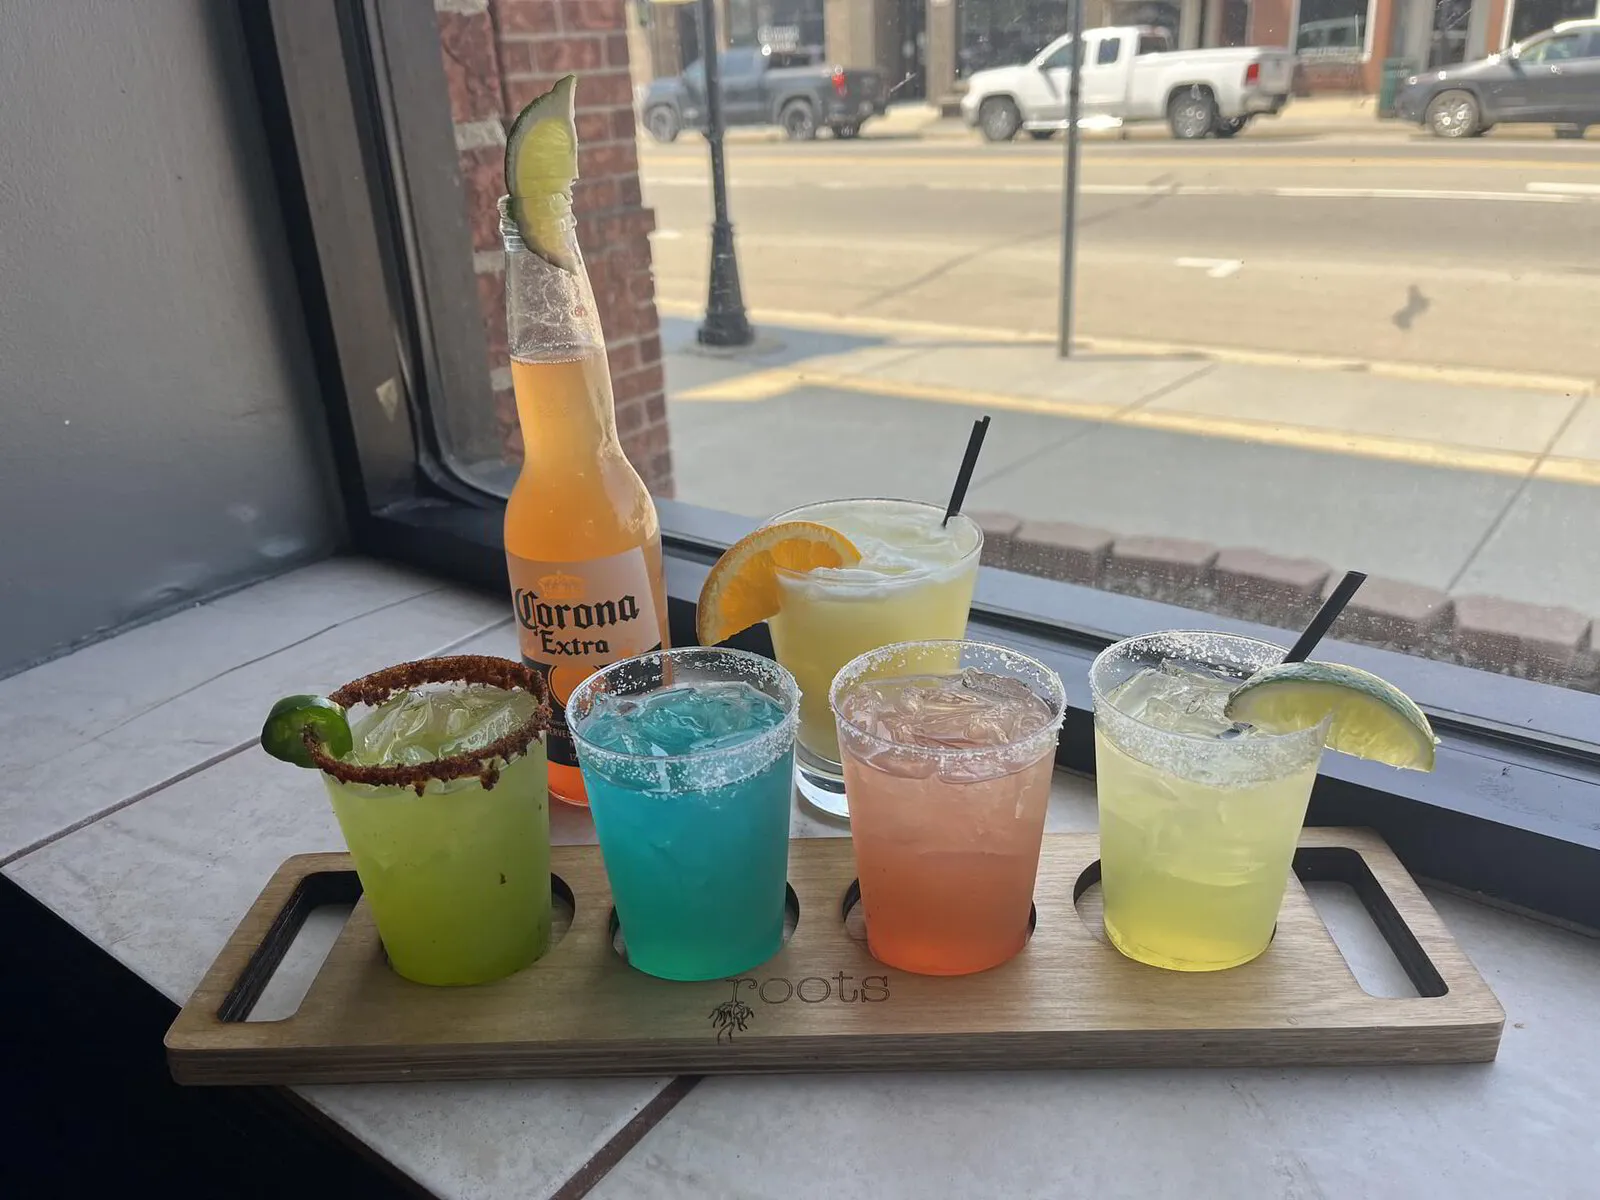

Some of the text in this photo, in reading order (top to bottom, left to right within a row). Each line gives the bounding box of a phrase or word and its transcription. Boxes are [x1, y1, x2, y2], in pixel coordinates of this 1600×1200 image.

[515, 588, 640, 635] Corona
[539, 629, 610, 656] Extra
[725, 970, 890, 1006] roots
